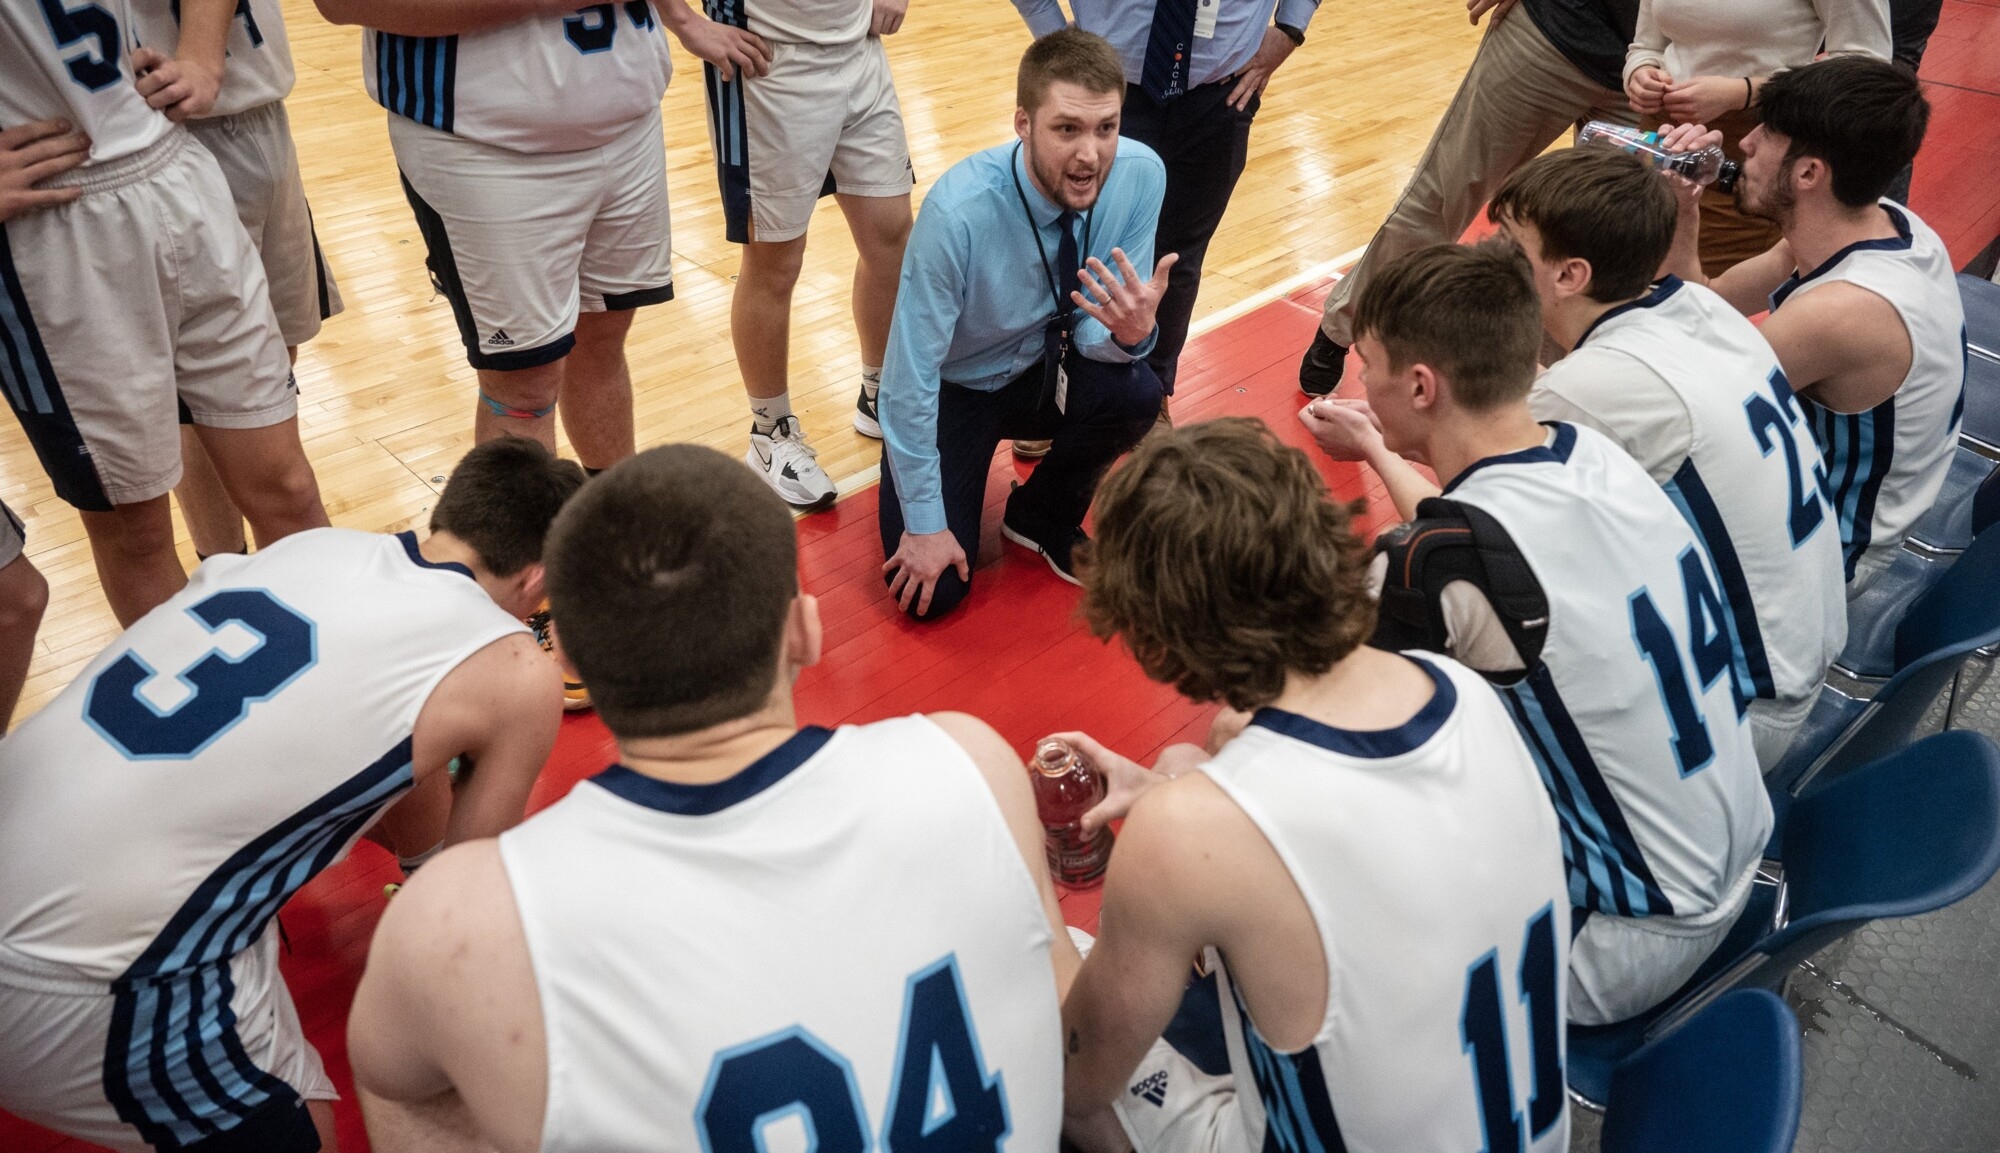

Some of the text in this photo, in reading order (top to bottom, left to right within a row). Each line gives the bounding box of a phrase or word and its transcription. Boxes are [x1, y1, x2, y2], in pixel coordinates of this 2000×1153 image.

[81, 587, 318, 762] 3
[1626, 541, 1750, 780] 14
[1130, 1070, 1168, 1097] adidas
[1458, 898, 1565, 1153] 11
